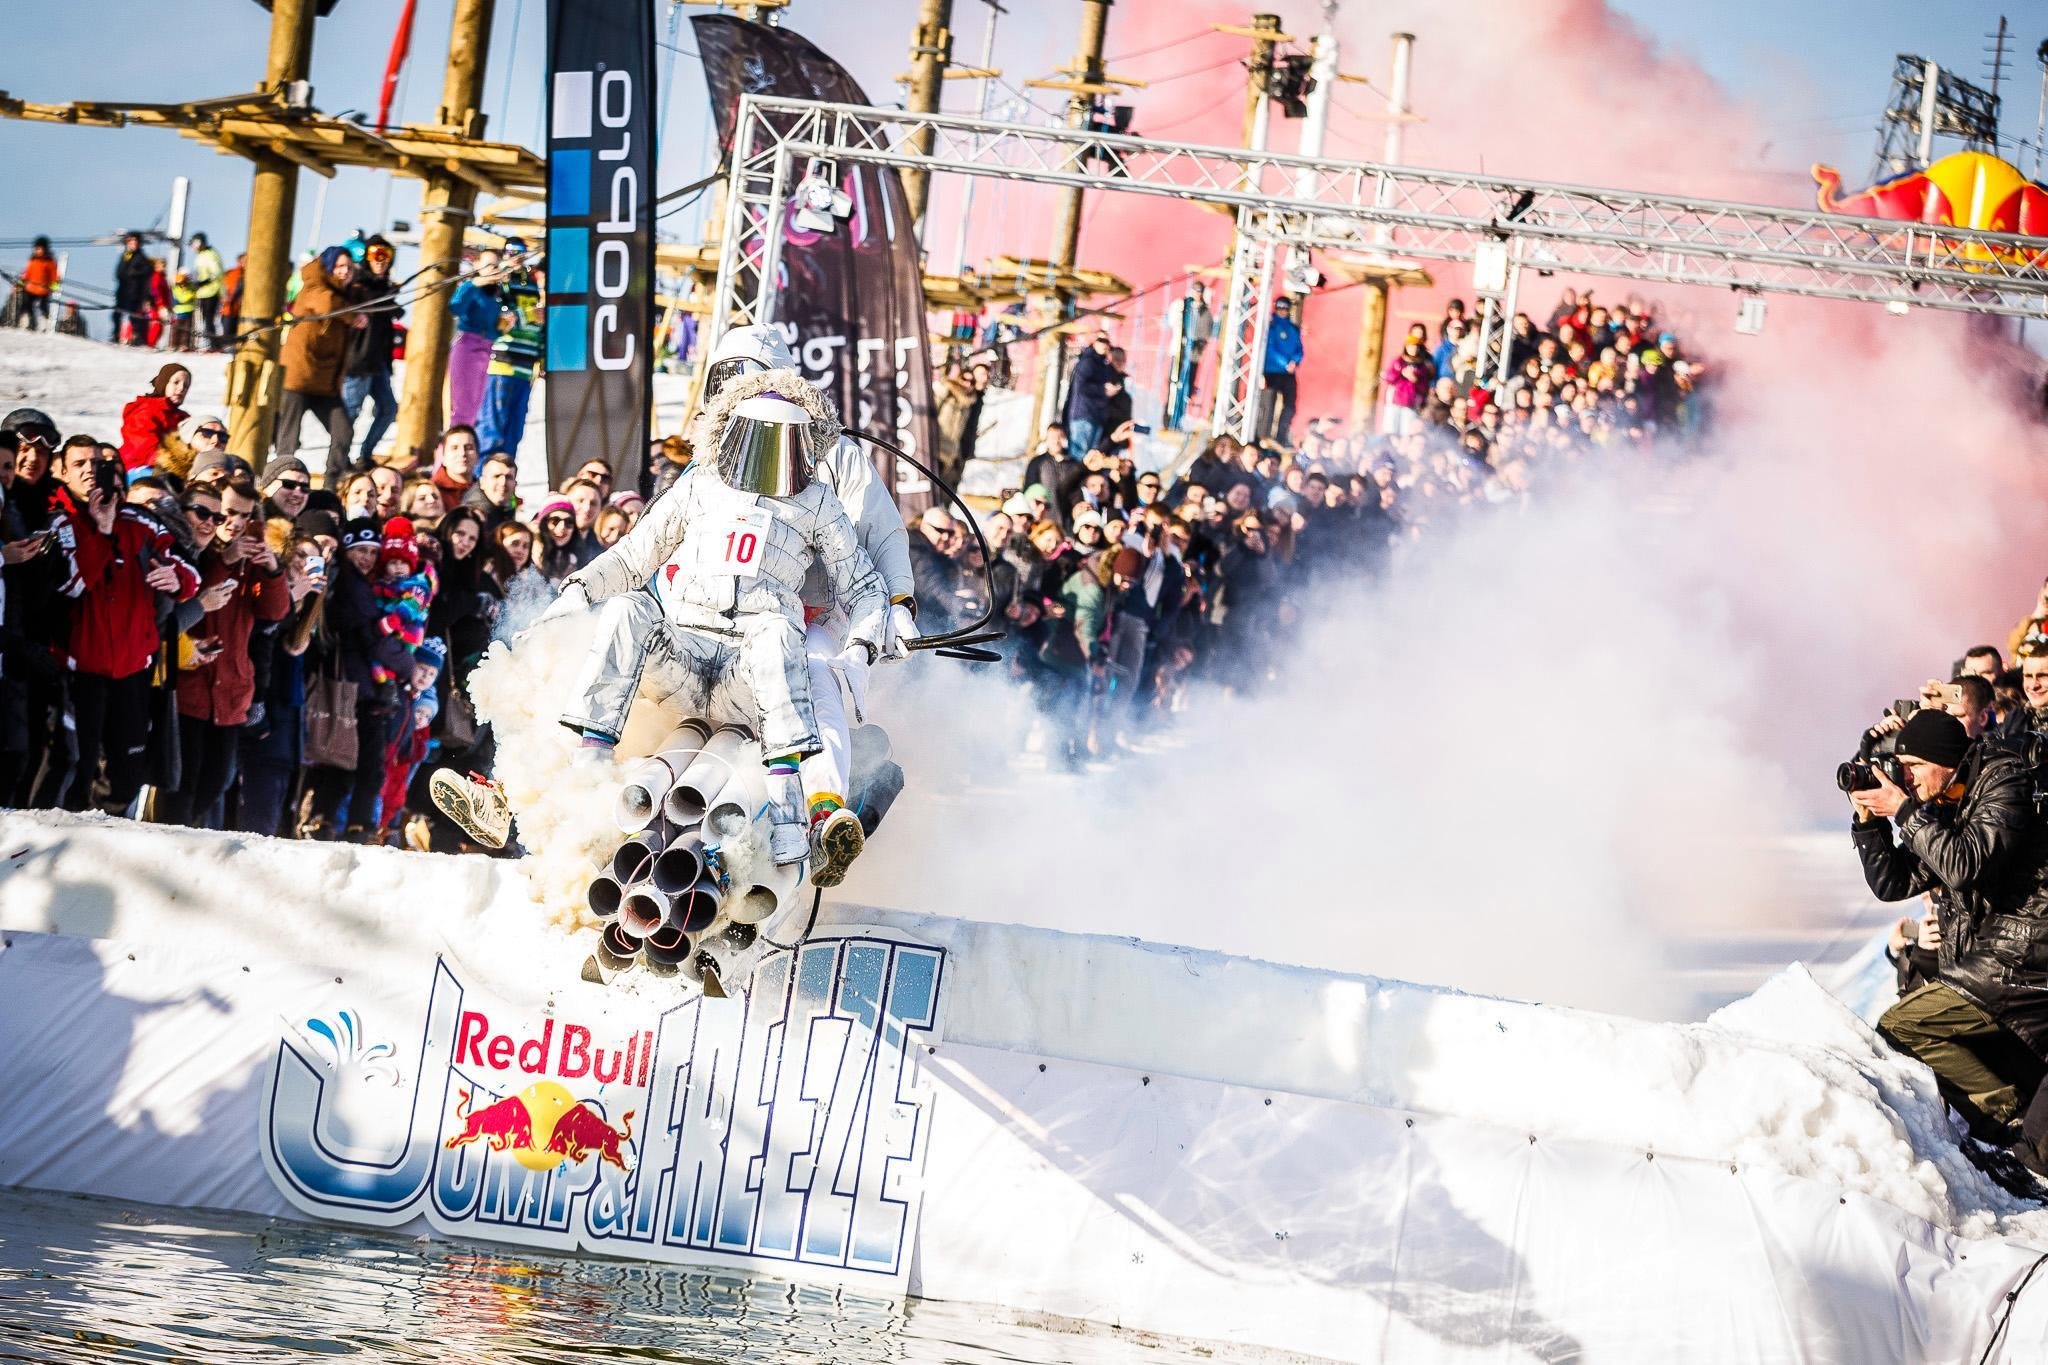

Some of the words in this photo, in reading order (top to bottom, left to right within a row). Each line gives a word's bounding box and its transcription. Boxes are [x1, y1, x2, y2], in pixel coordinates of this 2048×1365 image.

[725, 531, 757, 564] 10
[455, 1010, 554, 1074] Red
[557, 1023, 653, 1088] Bull
